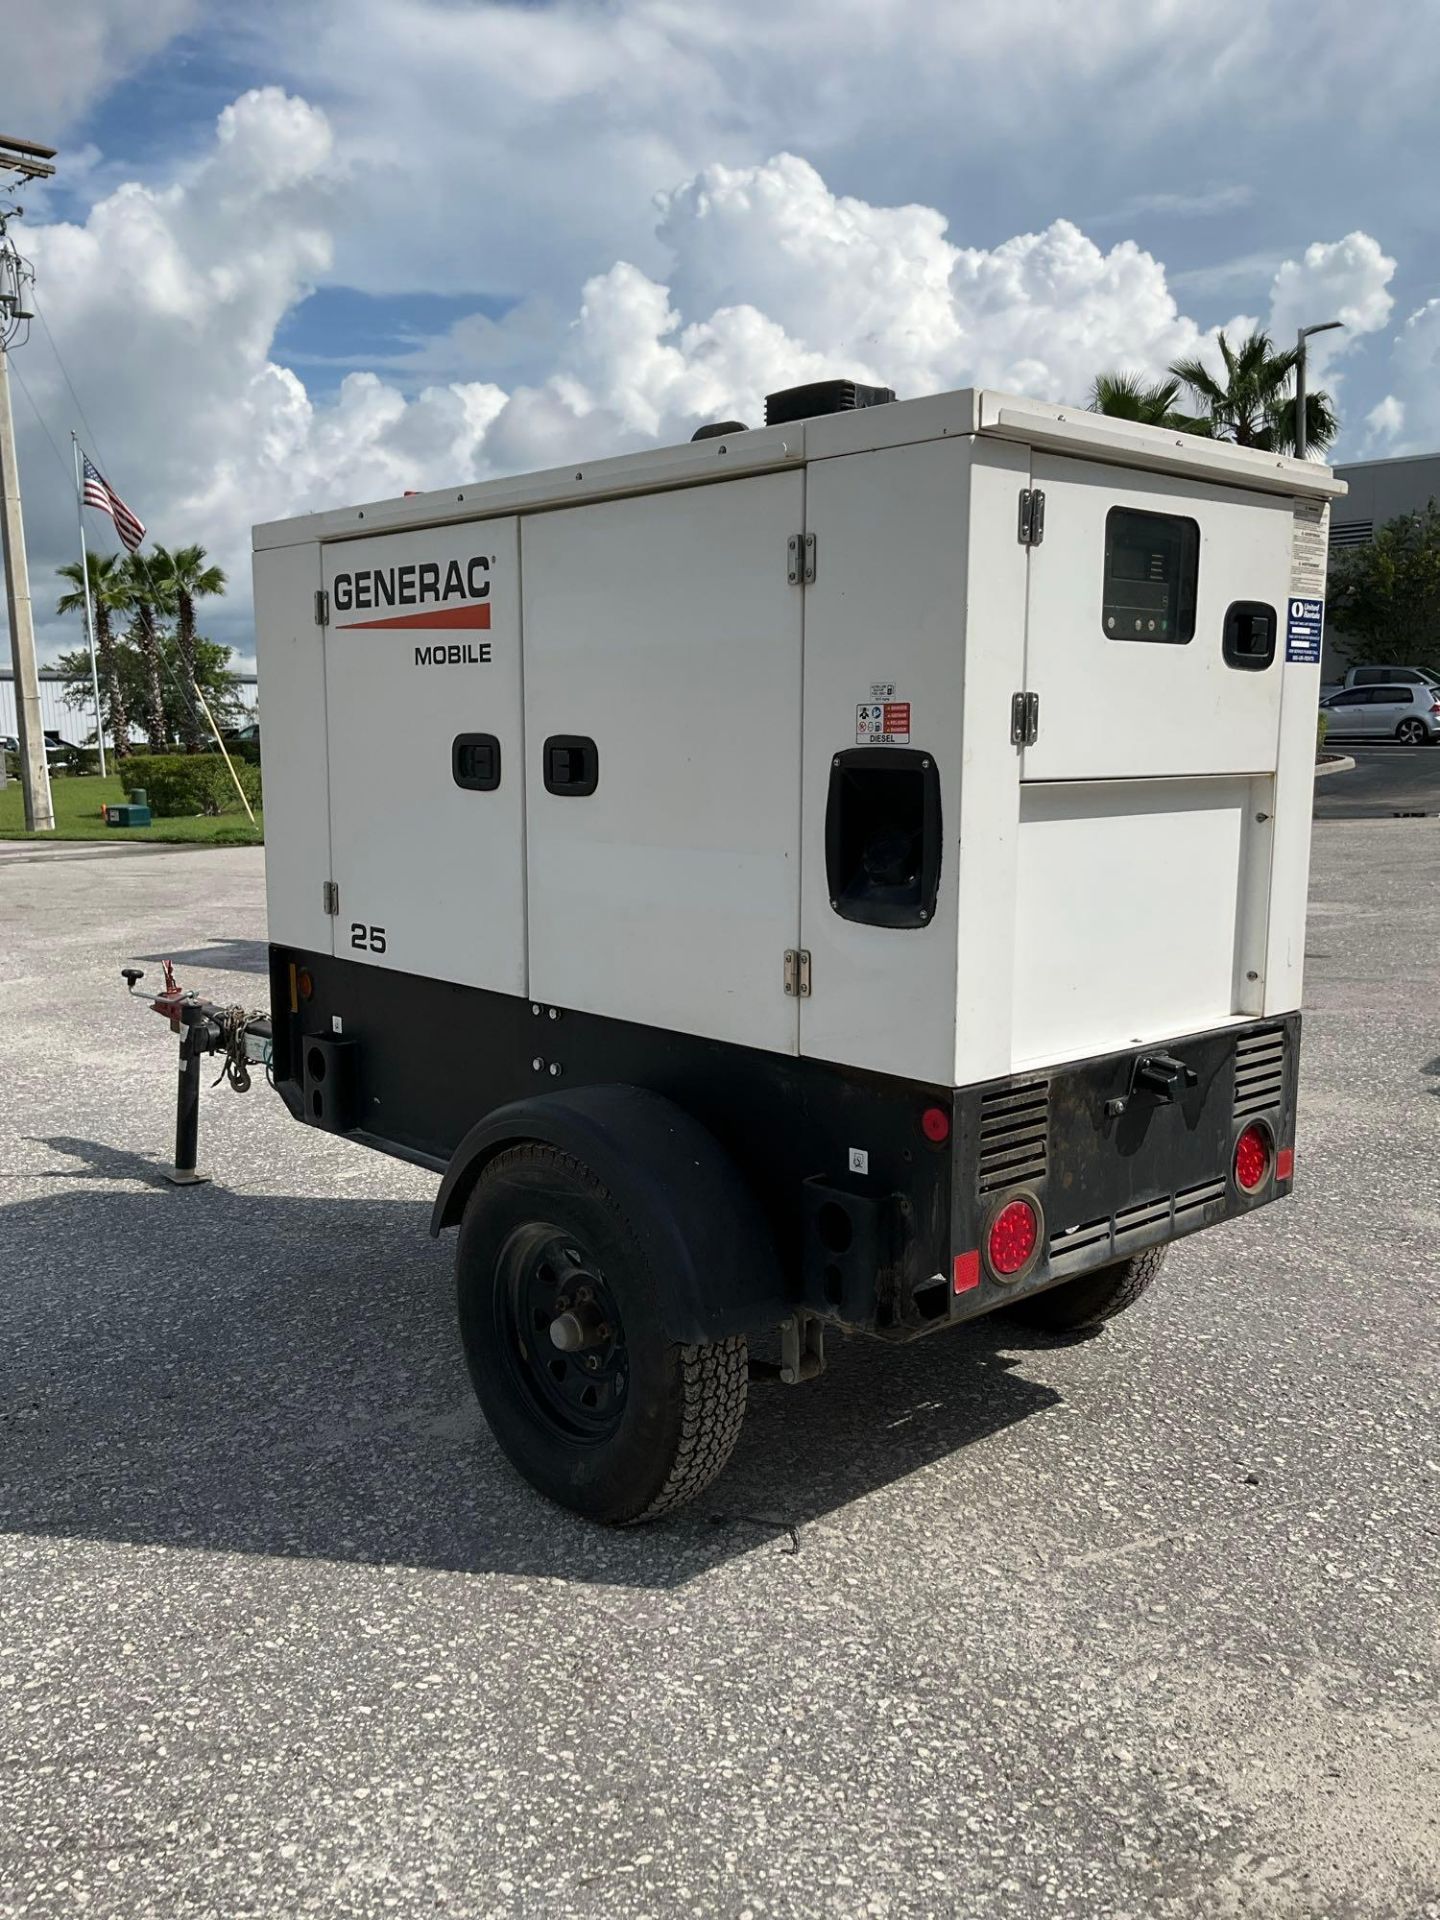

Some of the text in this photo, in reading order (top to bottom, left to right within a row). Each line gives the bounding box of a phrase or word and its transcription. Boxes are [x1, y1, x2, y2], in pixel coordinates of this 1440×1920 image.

[334, 556, 491, 611] GENERAC
[414, 643, 492, 666] MOBILE
[869, 734, 896, 743] DIESEL
[351, 922, 387, 954] 25
